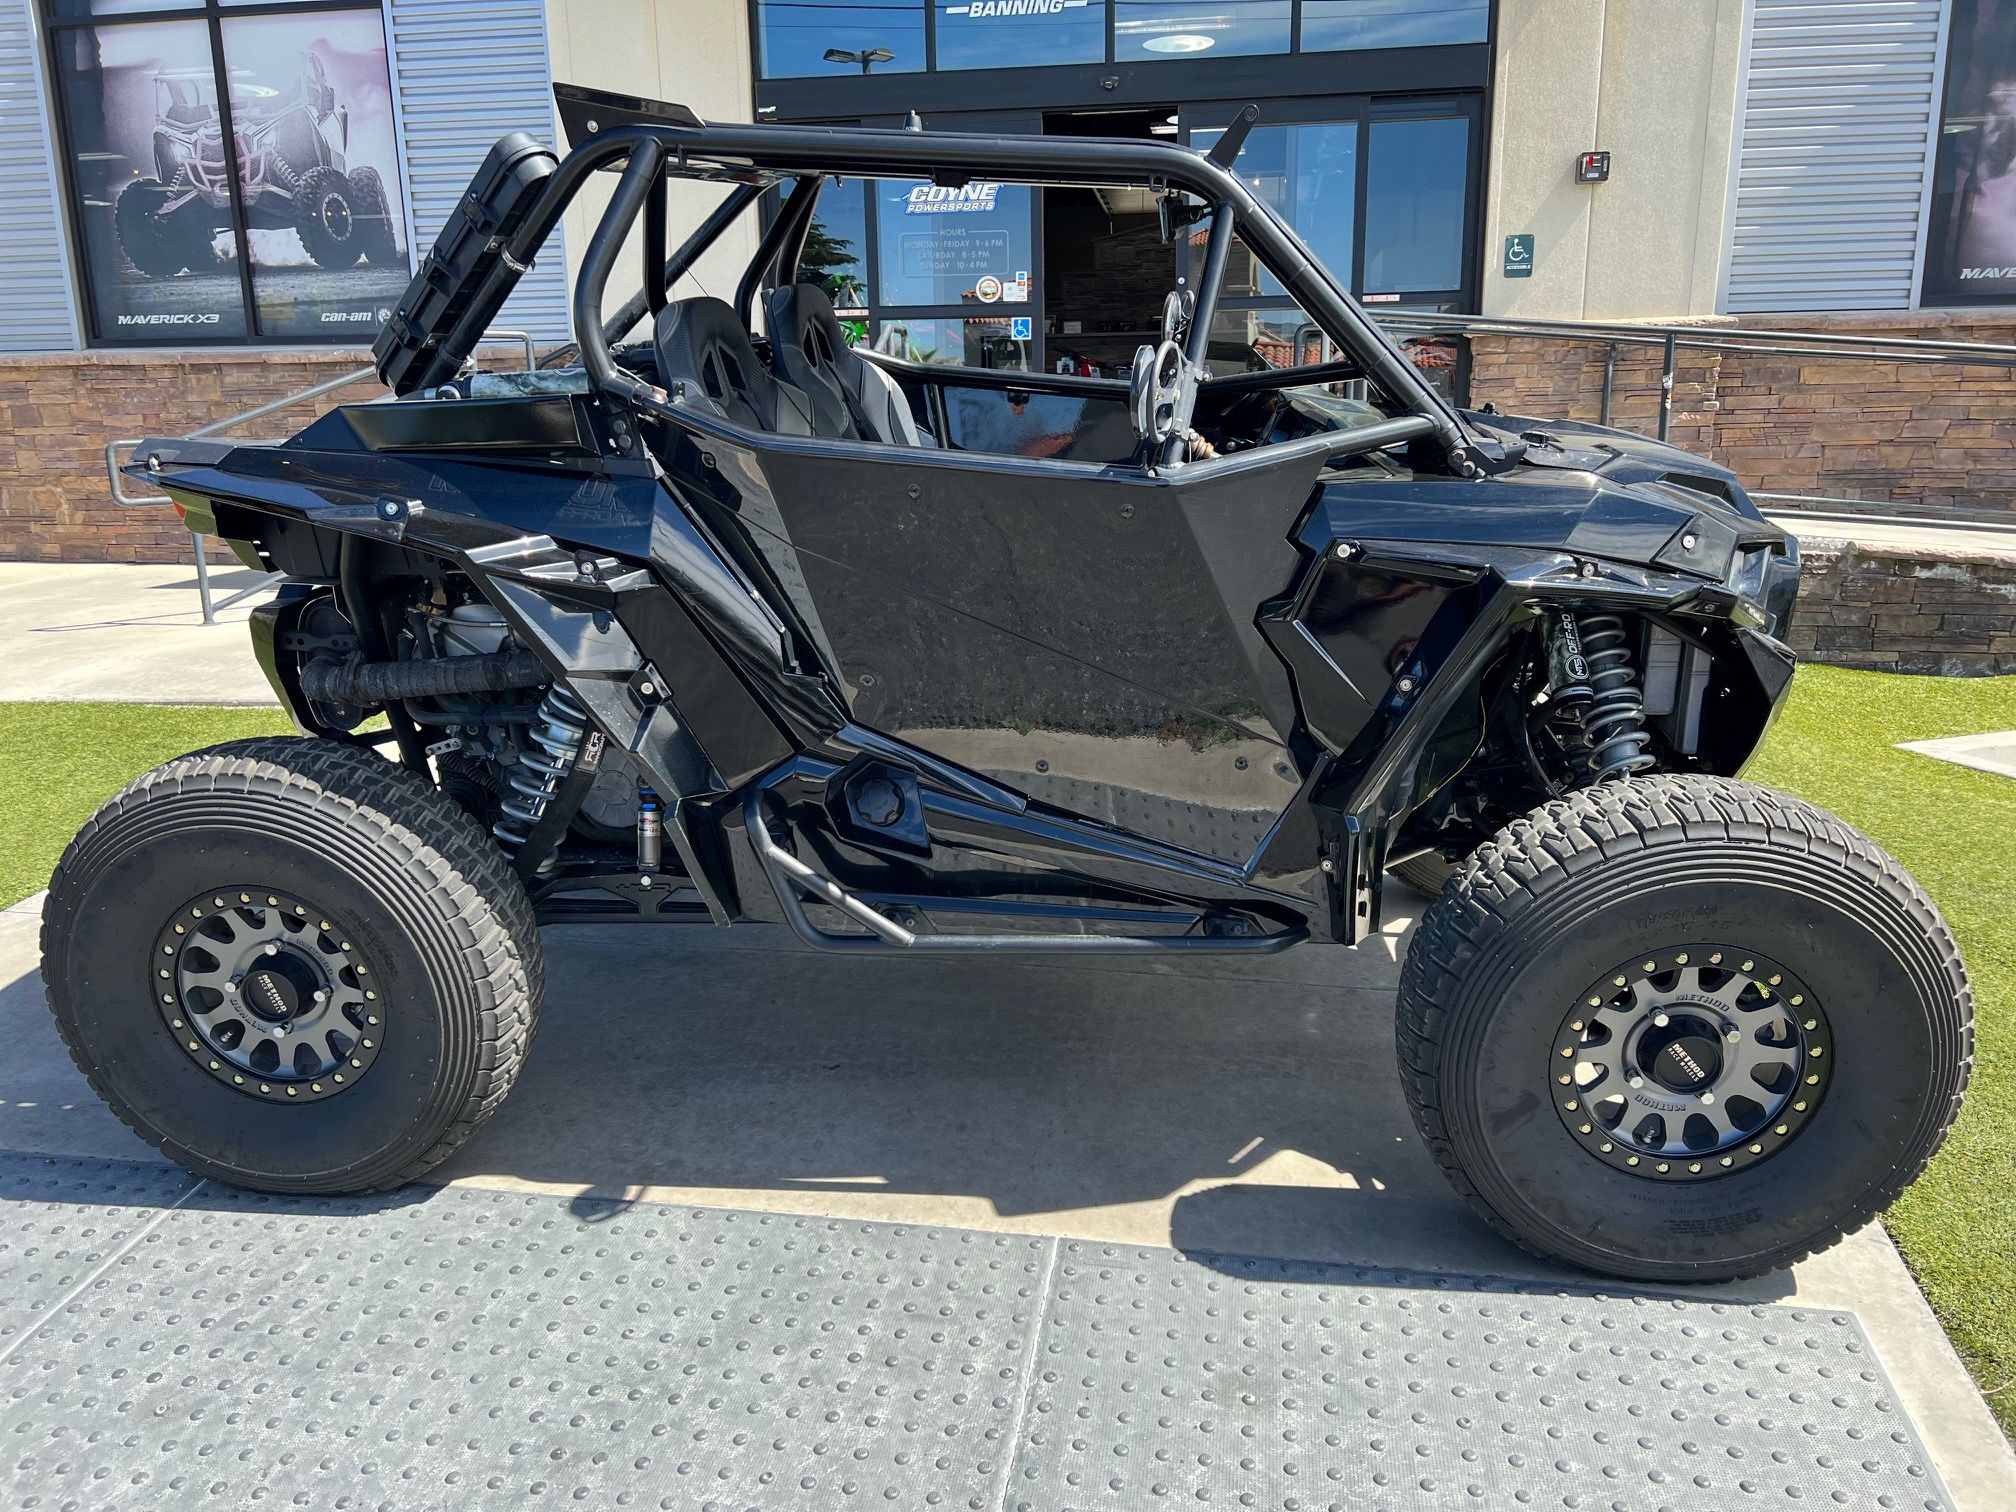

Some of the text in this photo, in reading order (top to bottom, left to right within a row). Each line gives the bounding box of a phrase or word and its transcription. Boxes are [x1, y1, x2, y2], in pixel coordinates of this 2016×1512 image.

[969, 0, 1064, 18] BANNING
[909, 184, 999, 202] COYNE
[906, 202, 995, 213] POWERSPORTS
[117, 313, 220, 325] MAVERICK X3
[321, 312, 372, 322] can-am
[261, 974, 287, 1012] METHOD
[1667, 1047, 1700, 1082] RACE WHEELS
[1672, 1043, 1705, 1078] METHOD
